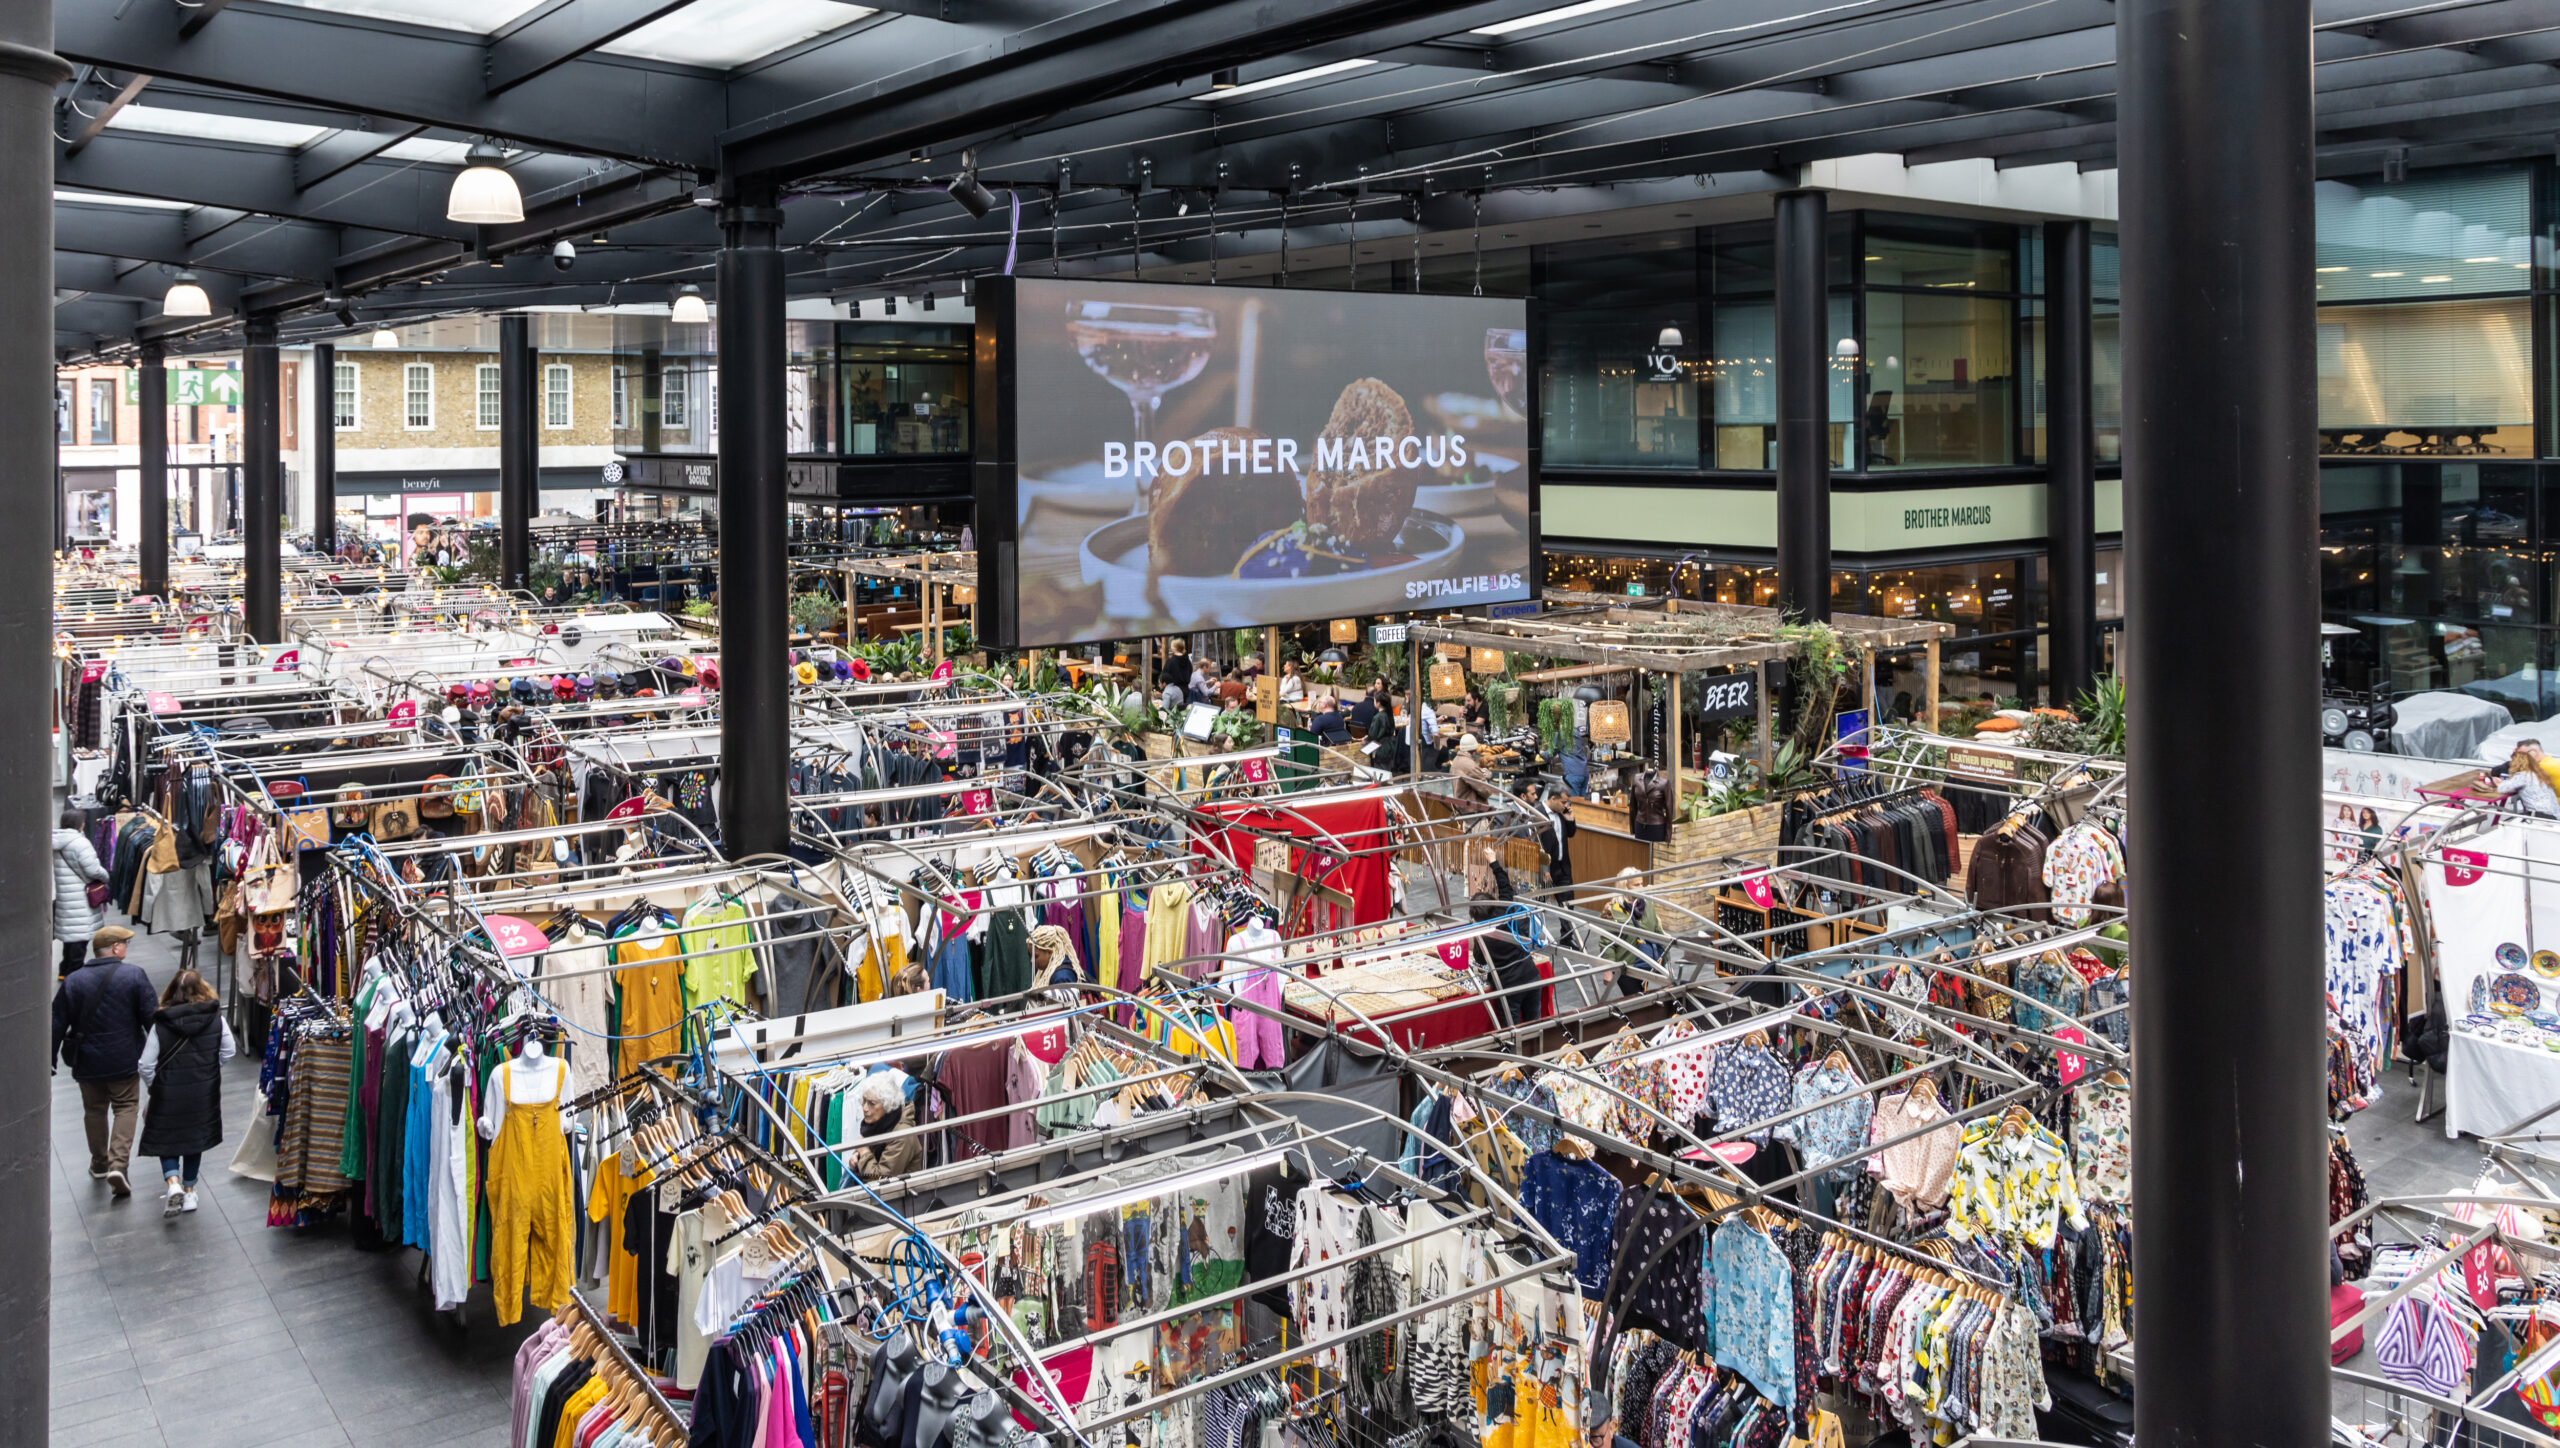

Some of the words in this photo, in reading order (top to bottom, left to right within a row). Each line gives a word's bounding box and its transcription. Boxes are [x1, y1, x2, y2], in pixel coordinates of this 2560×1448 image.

[1104, 438, 1299, 478] BROTHER
[1317, 435, 1467, 471] MARCUS
[685, 465, 712, 476] PLAYERS
[402, 477, 440, 491] benefit
[688, 476, 709, 486] SOCIAL
[1904, 508, 1949, 529] BROTHER
[1951, 505, 1991, 526] MARCUS
[1376, 627, 1406, 642] COFFEE
[1704, 681, 1749, 712] BEER
[397, 707, 409, 716] 39
[1250, 760, 1262, 769] CP
[1950, 752, 1980, 766] LEATHER
[1981, 756, 2014, 771] REPUBLIC
[1252, 769, 1263, 779] 43
[973, 793, 987, 803] CP
[619, 806, 634, 817] 45
[974, 801, 988, 814] 44
[1320, 856, 1331, 867] 48
[2455, 866, 2471, 879] 75
[1755, 885, 1766, 898] 49
[500, 924, 520, 937] 46
[504, 936, 527, 948] CP
[1449, 945, 1462, 960] 50
[1043, 1033, 1057, 1050] 51
[2066, 1054, 2080, 1073] 54
[2474, 1245, 2488, 1270] CP
[2477, 1270, 2489, 1295] 56
